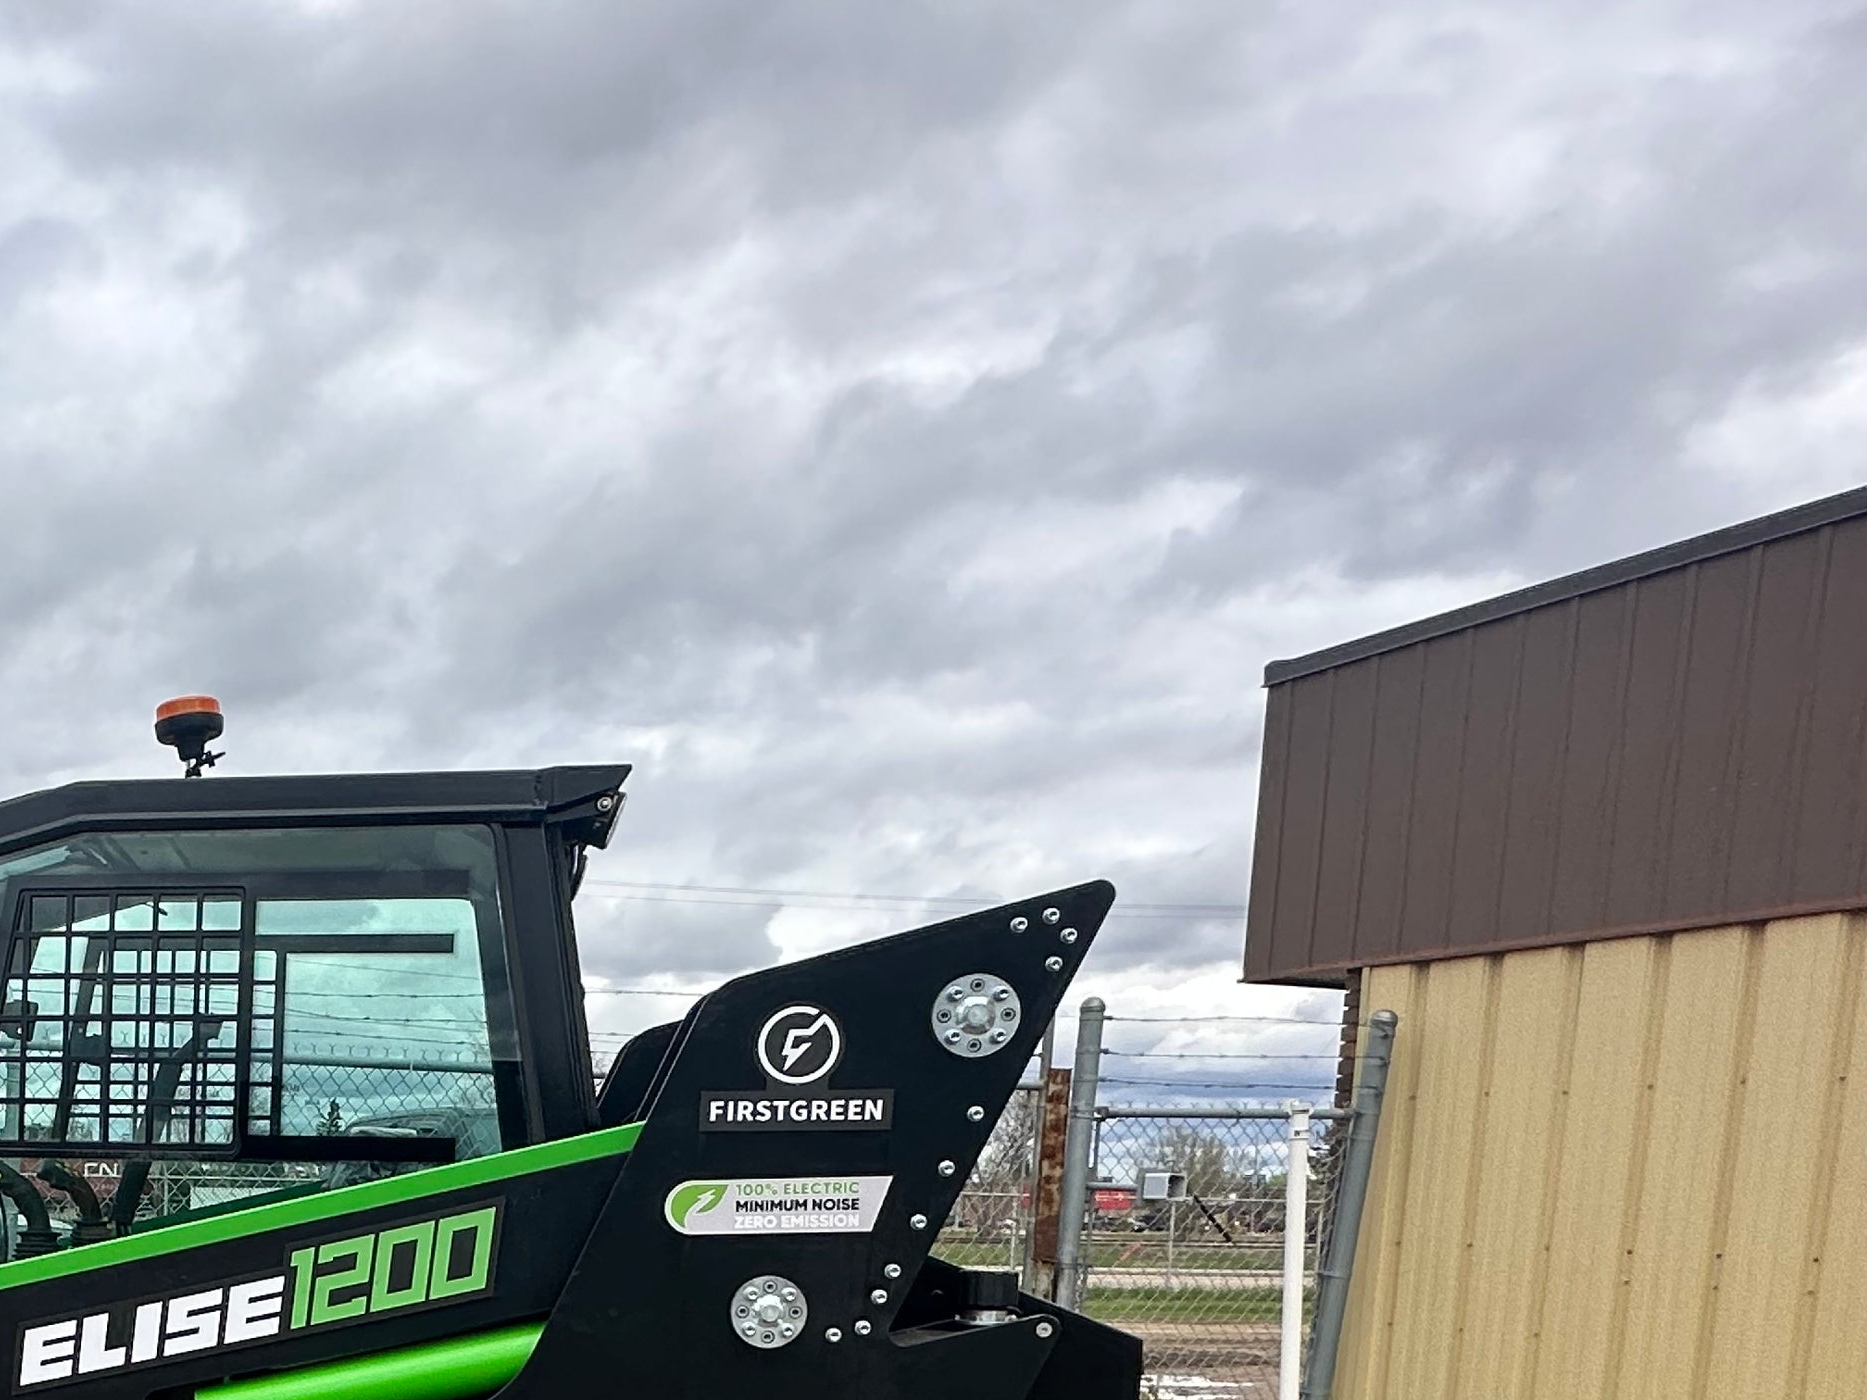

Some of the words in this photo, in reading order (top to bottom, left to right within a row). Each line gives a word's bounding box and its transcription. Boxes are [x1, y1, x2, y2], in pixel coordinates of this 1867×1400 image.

[709, 1099, 884, 1123] FIRSTGREEN
[736, 1183, 779, 1196] 100%
[783, 1181, 860, 1195] ELECTRIC
[735, 1199, 809, 1213] MINIMUM
[812, 1198, 861, 1211] NOISE
[734, 1214, 777, 1229] ZERO
[780, 1213, 861, 1228] EMISSION
